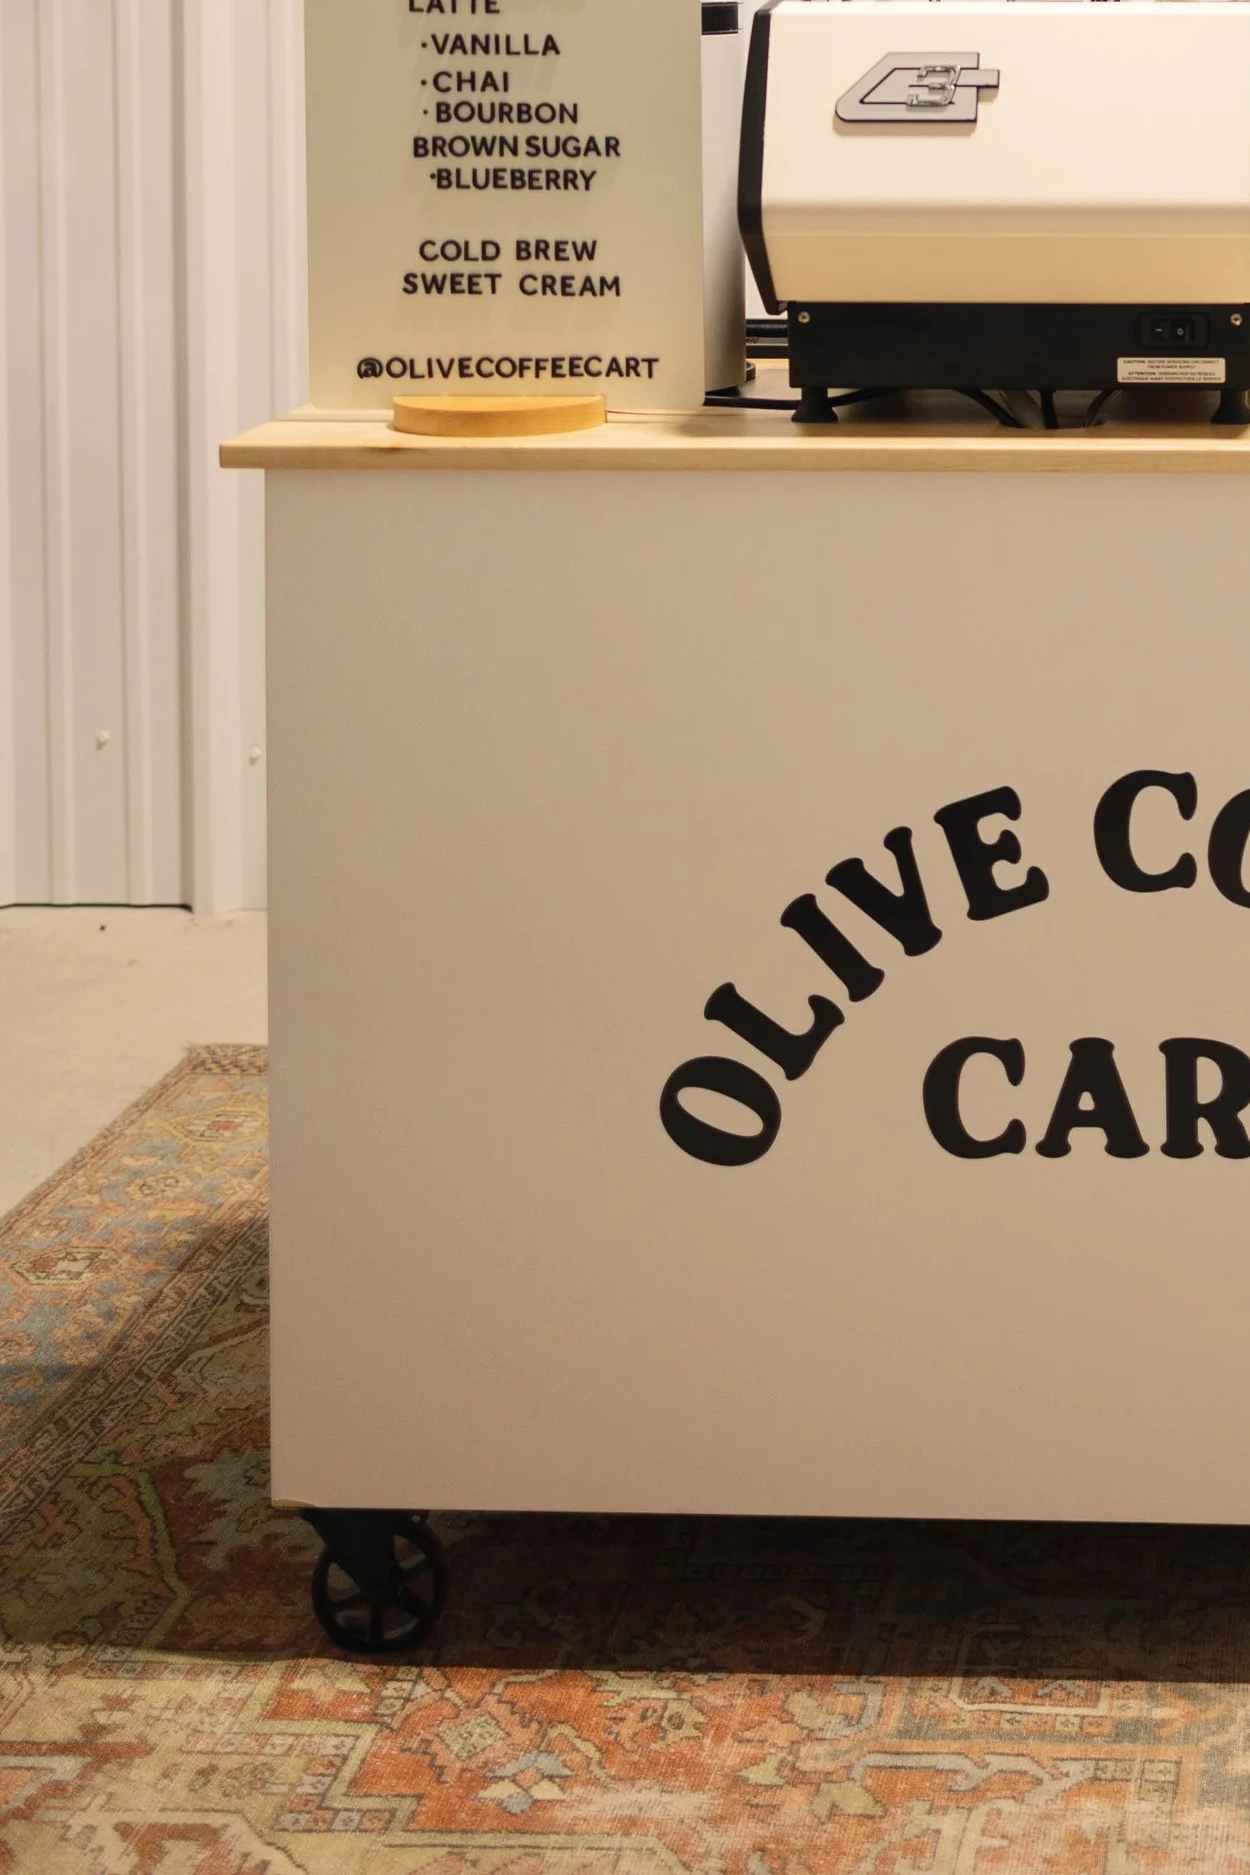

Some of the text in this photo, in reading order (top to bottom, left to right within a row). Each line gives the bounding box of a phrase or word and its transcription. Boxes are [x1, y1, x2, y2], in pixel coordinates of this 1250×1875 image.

[430, 33, 561, 57] VANILLA
[432, 70, 509, 94] CHAI
[435, 101, 578, 125] BOURBON
[413, 135, 621, 159] BROWN SUGAR
[434, 167, 597, 192] BLUEBERRY
[419, 239, 597, 263] COLD BREW
[402, 272, 621, 298] SWEET CREAM
[356, 356, 659, 380] @OLIVECOFFEECART
[660, 786, 1049, 1166] OLIVE
